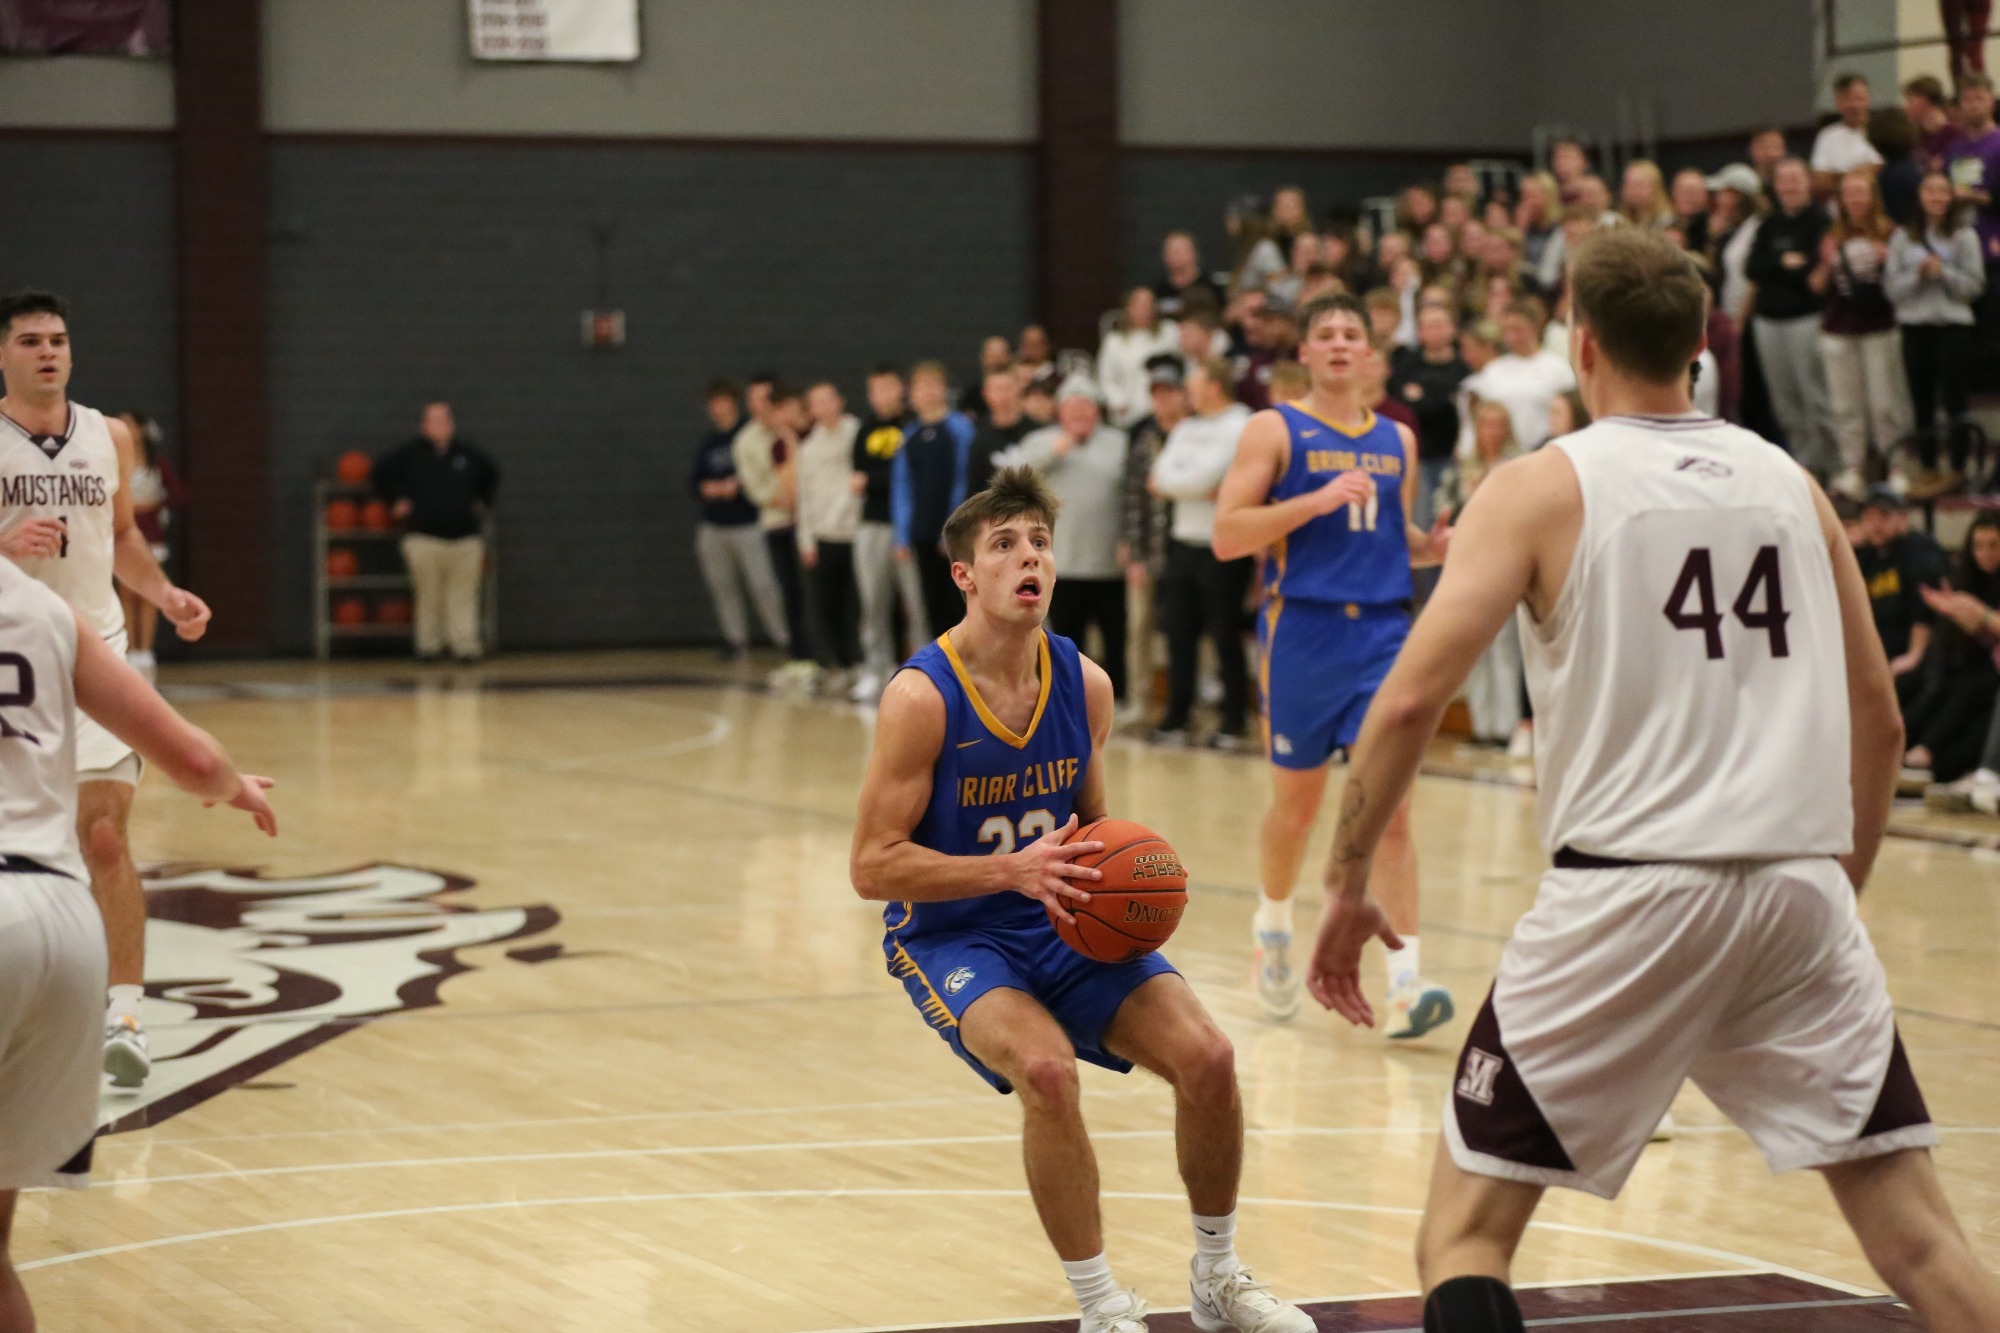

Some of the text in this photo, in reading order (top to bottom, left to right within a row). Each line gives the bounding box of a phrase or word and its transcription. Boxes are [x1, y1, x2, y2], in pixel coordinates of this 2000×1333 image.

[2, 474, 107, 507] MUSTANGS
[1662, 545, 1791, 660] 44
[957, 758, 1079, 807] RIAR CLIFF
[1132, 862, 1183, 881] EGACY
